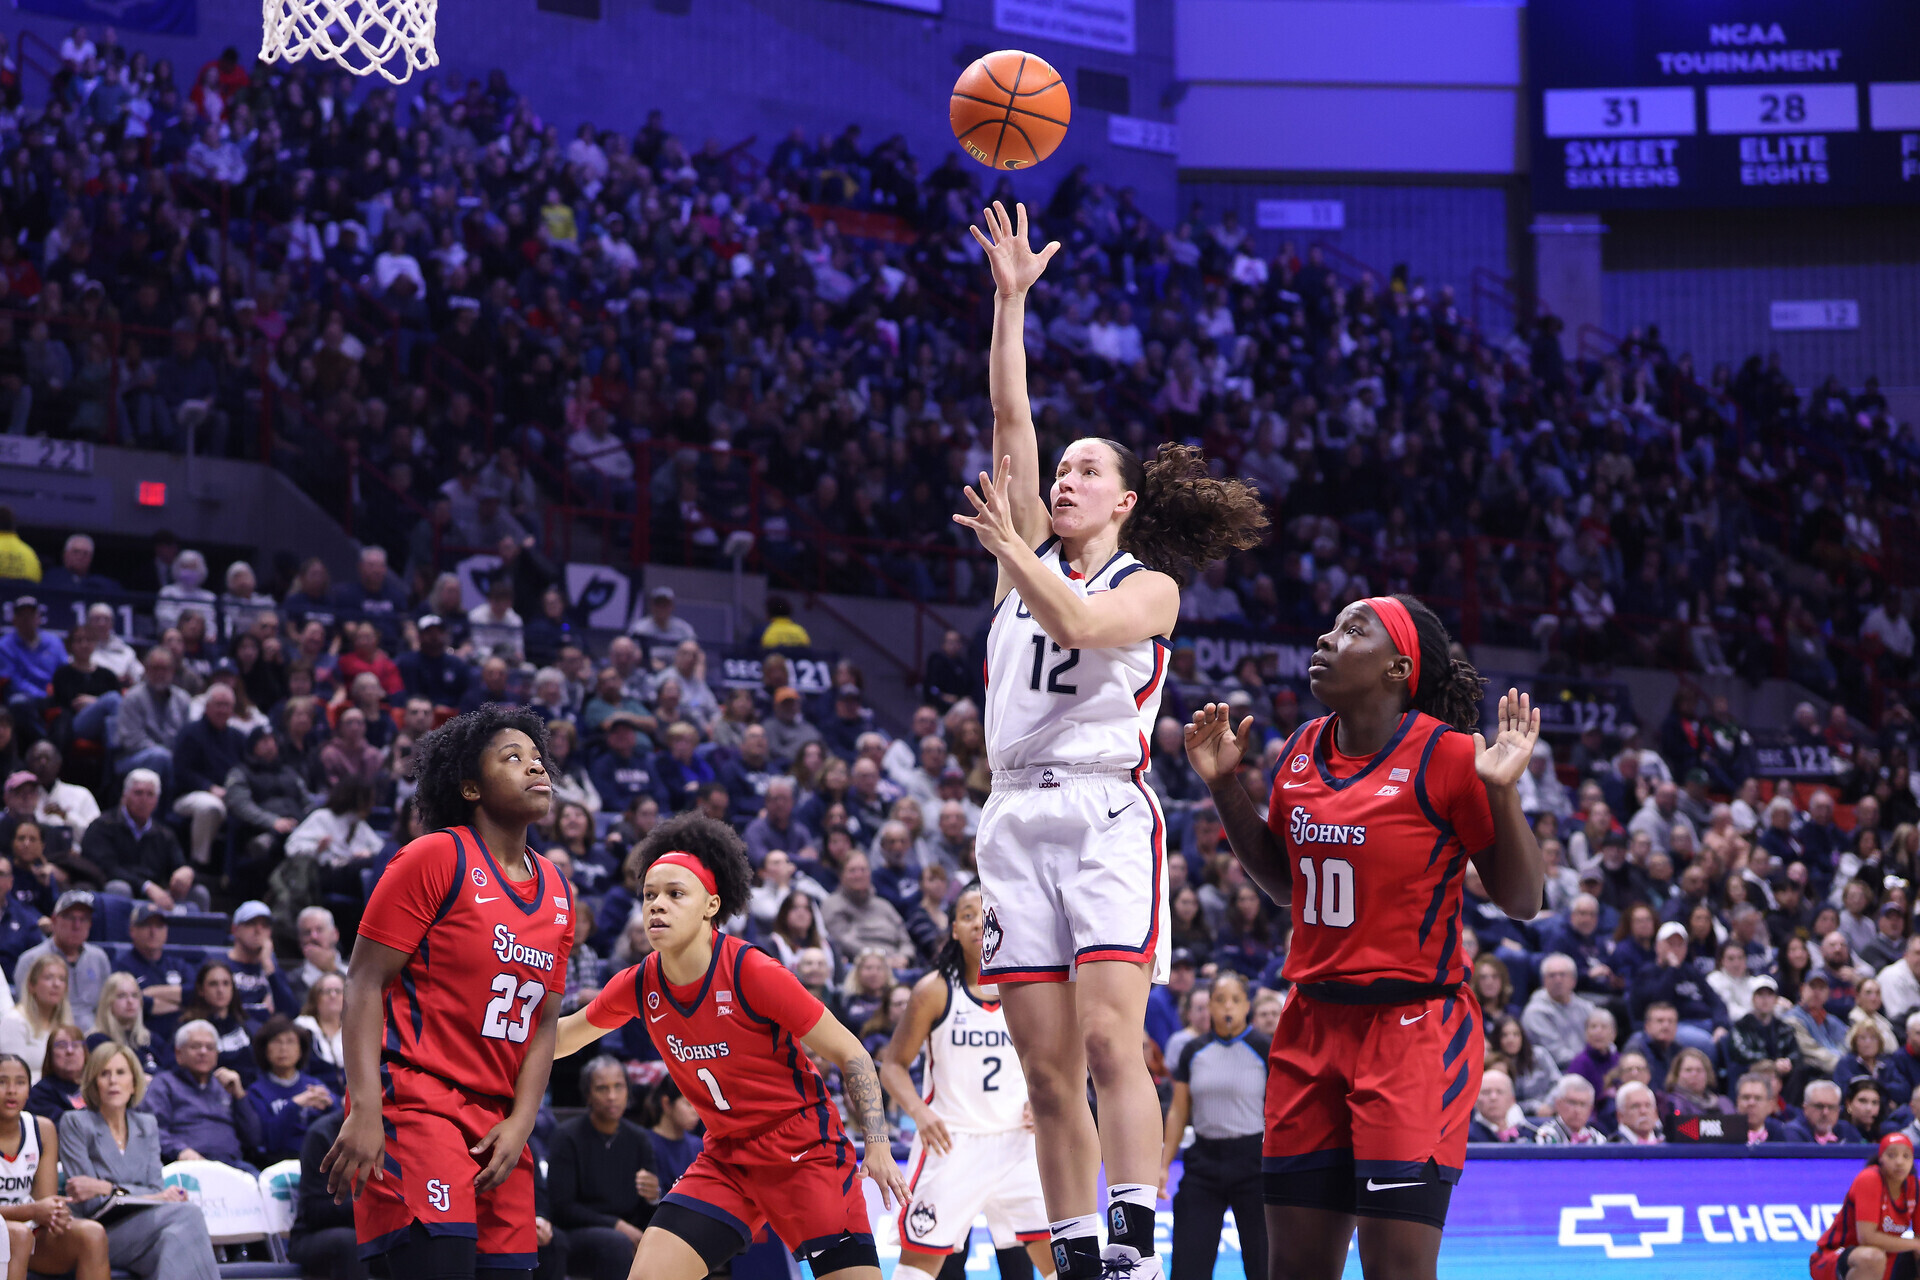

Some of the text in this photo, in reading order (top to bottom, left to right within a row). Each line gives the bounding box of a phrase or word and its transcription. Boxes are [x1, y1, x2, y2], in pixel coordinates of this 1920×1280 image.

[1709, 23, 1786, 46] NCAA
[1657, 49, 1841, 75] TOURNAMENT
[1602, 98, 1640, 128] 31
[1759, 94, 1806, 125] 28
[1565, 139, 1679, 167] SWEET
[1739, 136, 1828, 163] ELITE
[1565, 166, 1680, 189] SIXTEENS
[1740, 163, 1830, 186] EIGHTS
[724, 659, 763, 679] SEC
[1030, 634, 1080, 695] 12
[1299, 856, 1355, 928] 10
[481, 972, 546, 1044] 23
[952, 1029, 1013, 1047] UCON
[983, 1056, 1002, 1092] 2
[697, 1067, 732, 1111] 1
